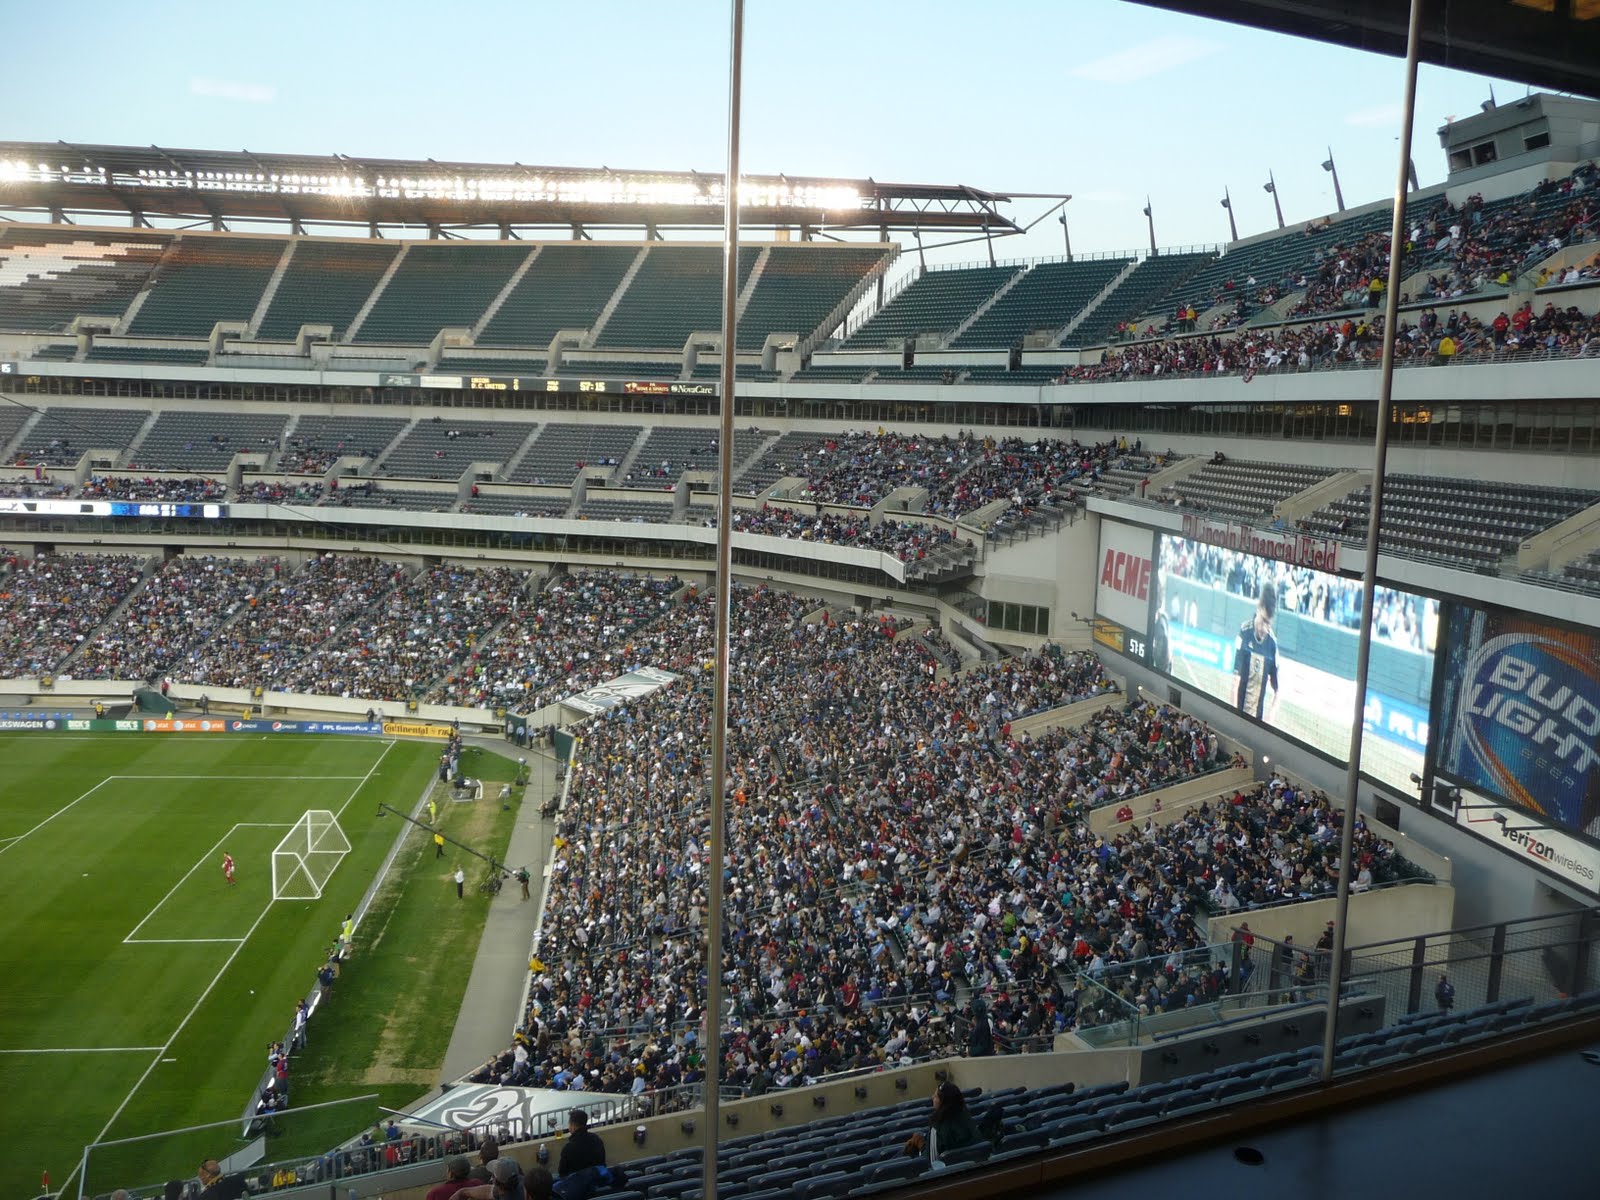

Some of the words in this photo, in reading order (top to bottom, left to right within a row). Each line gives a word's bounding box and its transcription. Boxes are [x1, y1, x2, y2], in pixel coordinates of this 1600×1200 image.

[580, 381, 606, 392] 57:15
[677, 385, 713, 394] NovaCare
[1193, 516, 1237, 548] Lincoln
[1239, 524, 1299, 563] Financial
[1301, 536, 1338, 571] Field
[1101, 548, 1152, 601] ACME
[1489, 654, 1600, 737] BUD
[383, 723, 429, 735] Continental
[1470, 683, 1600, 774] LIGHT
[1520, 747, 1575, 789] BEER
[1553, 850, 1595, 881] wireless
